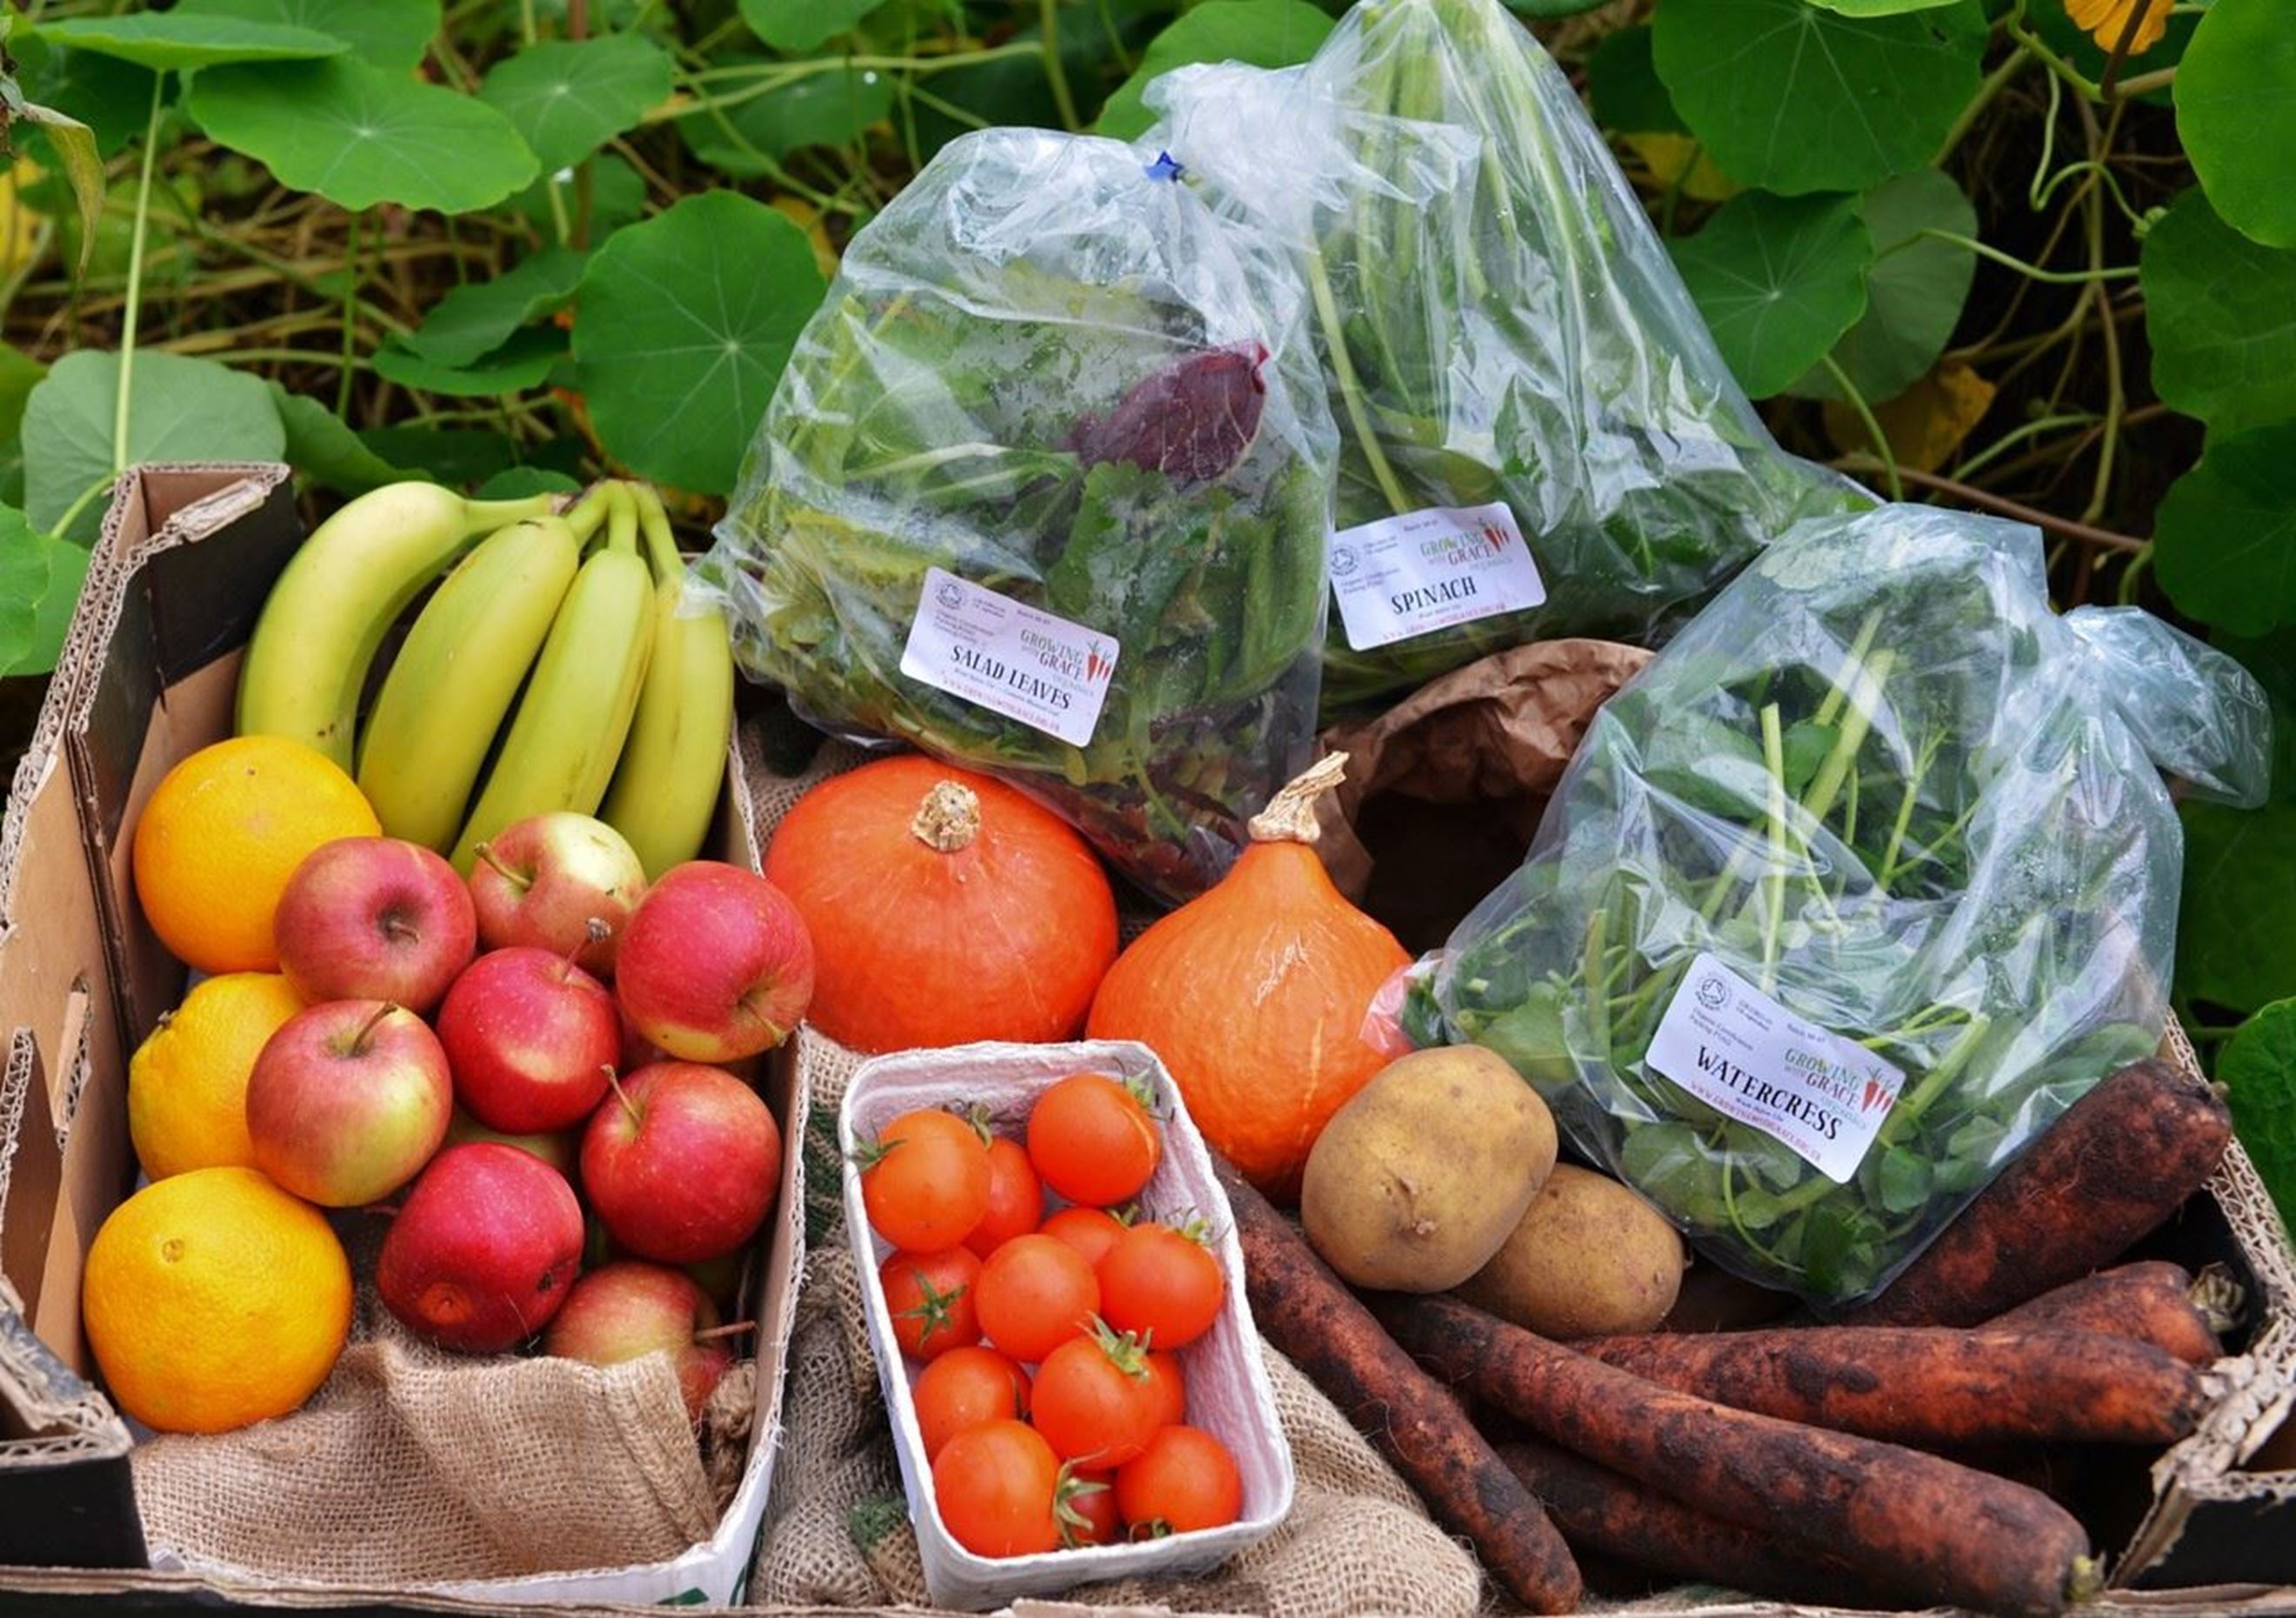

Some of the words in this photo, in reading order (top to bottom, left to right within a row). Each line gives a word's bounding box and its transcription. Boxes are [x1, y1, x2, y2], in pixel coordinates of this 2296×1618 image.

[1420, 532, 1484, 557] GROWING
[1448, 545, 1492, 565] GRACE
[1392, 576, 1477, 615] SPINACH
[1020, 629, 1084, 665] GROWING
[951, 645, 1004, 679] SALAD
[1009, 669, 1072, 709] LEAVES
[1039, 652, 1083, 680] GRACE
[1785, 1047, 1859, 1091] GROWING
[1697, 1046, 1842, 1140] WATERCRESS
[1805, 1072, 1859, 1107] GRACE
